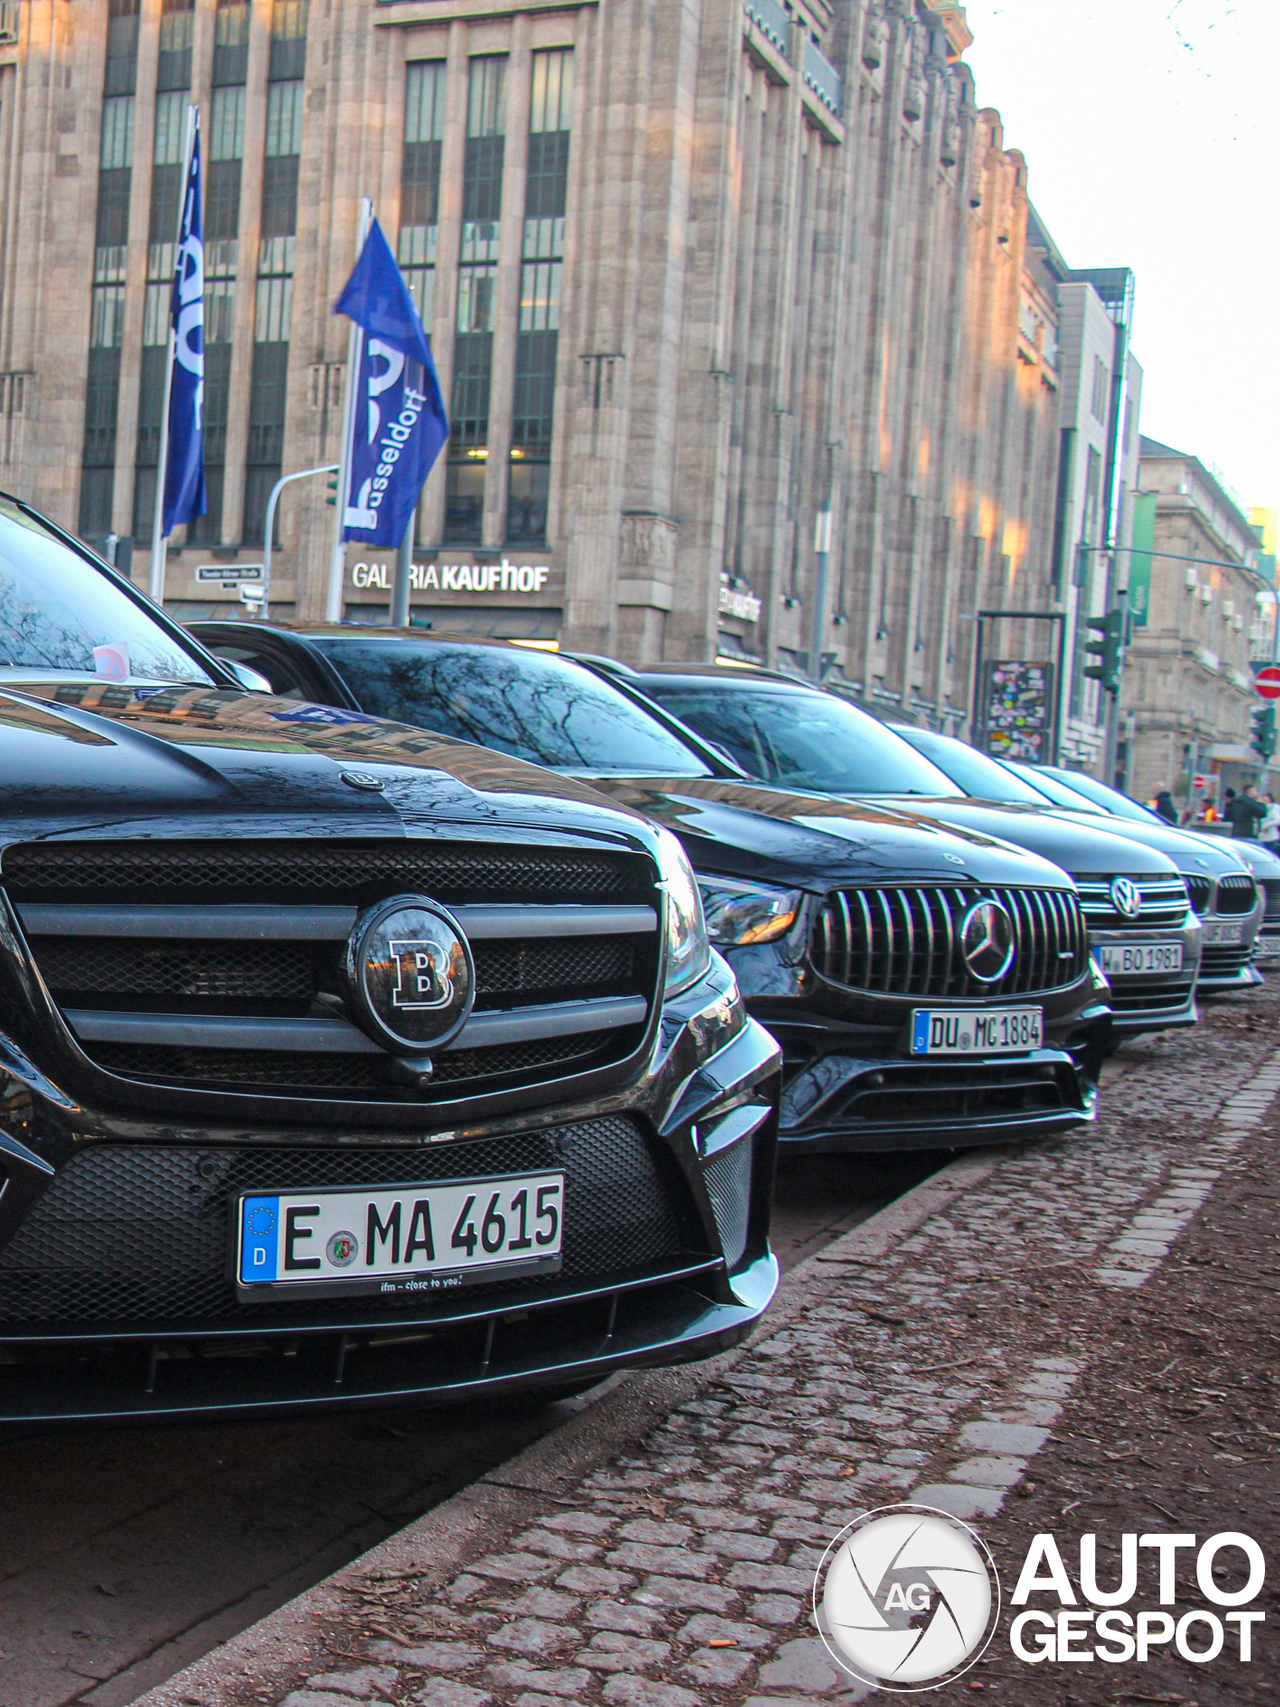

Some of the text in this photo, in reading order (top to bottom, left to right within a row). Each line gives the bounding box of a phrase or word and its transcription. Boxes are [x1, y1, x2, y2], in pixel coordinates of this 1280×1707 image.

[352, 562, 439, 589] GALRIA
[930, 1017, 959, 1048] DU
[284, 1204, 320, 1271] E
[365, 1198, 435, 1266] MA
[451, 1184, 560, 1257] 4615
[253, 1247, 266, 1266] D
[380, 1282, 396, 1292] ifm
[405, 1280, 428, 1291] close
[431, 1278, 440, 1288] to
[443, 1274, 463, 1288] you!
